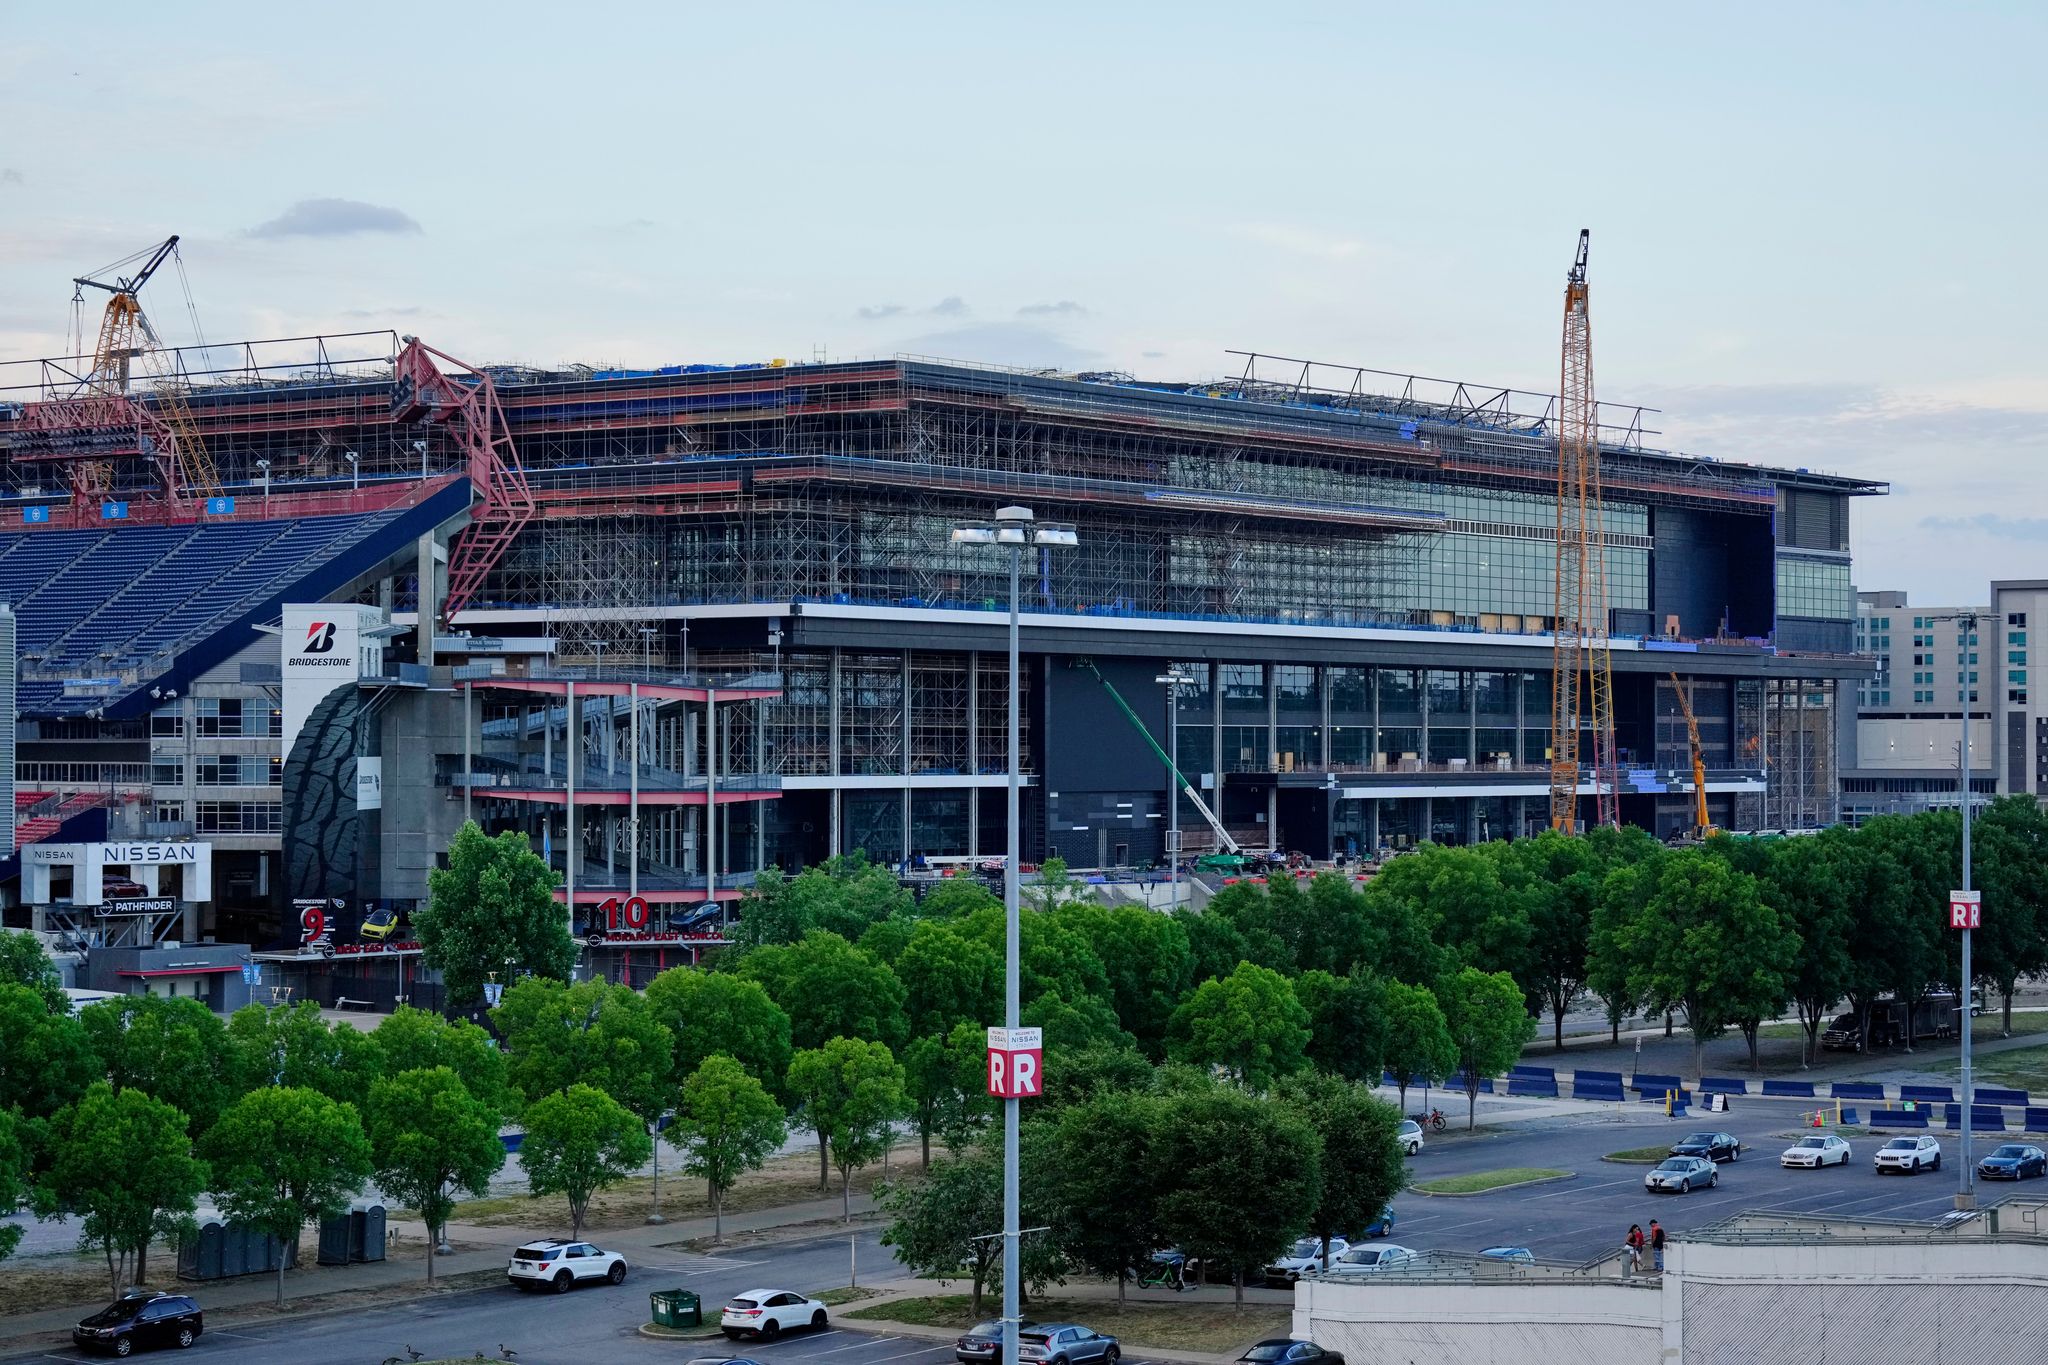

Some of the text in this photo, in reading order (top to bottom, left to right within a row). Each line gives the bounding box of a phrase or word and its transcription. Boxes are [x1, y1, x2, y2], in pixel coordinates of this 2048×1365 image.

[288, 657, 352, 667] BRIDGESTONE
[34, 851, 75, 860] NISSAN
[104, 846, 195, 862] NISSAN
[115, 900, 173, 912] PATHFINDER
[597, 896, 649, 930] 10
[1953, 904, 1967, 926] R
[1971, 904, 1979, 926] R
[300, 906, 325, 943] 9
[654, 931, 680, 941] EAST
[1011, 1035, 1039, 1043] NISSAN
[990, 1052, 1005, 1094] R
[1013, 1053, 1036, 1094] R
